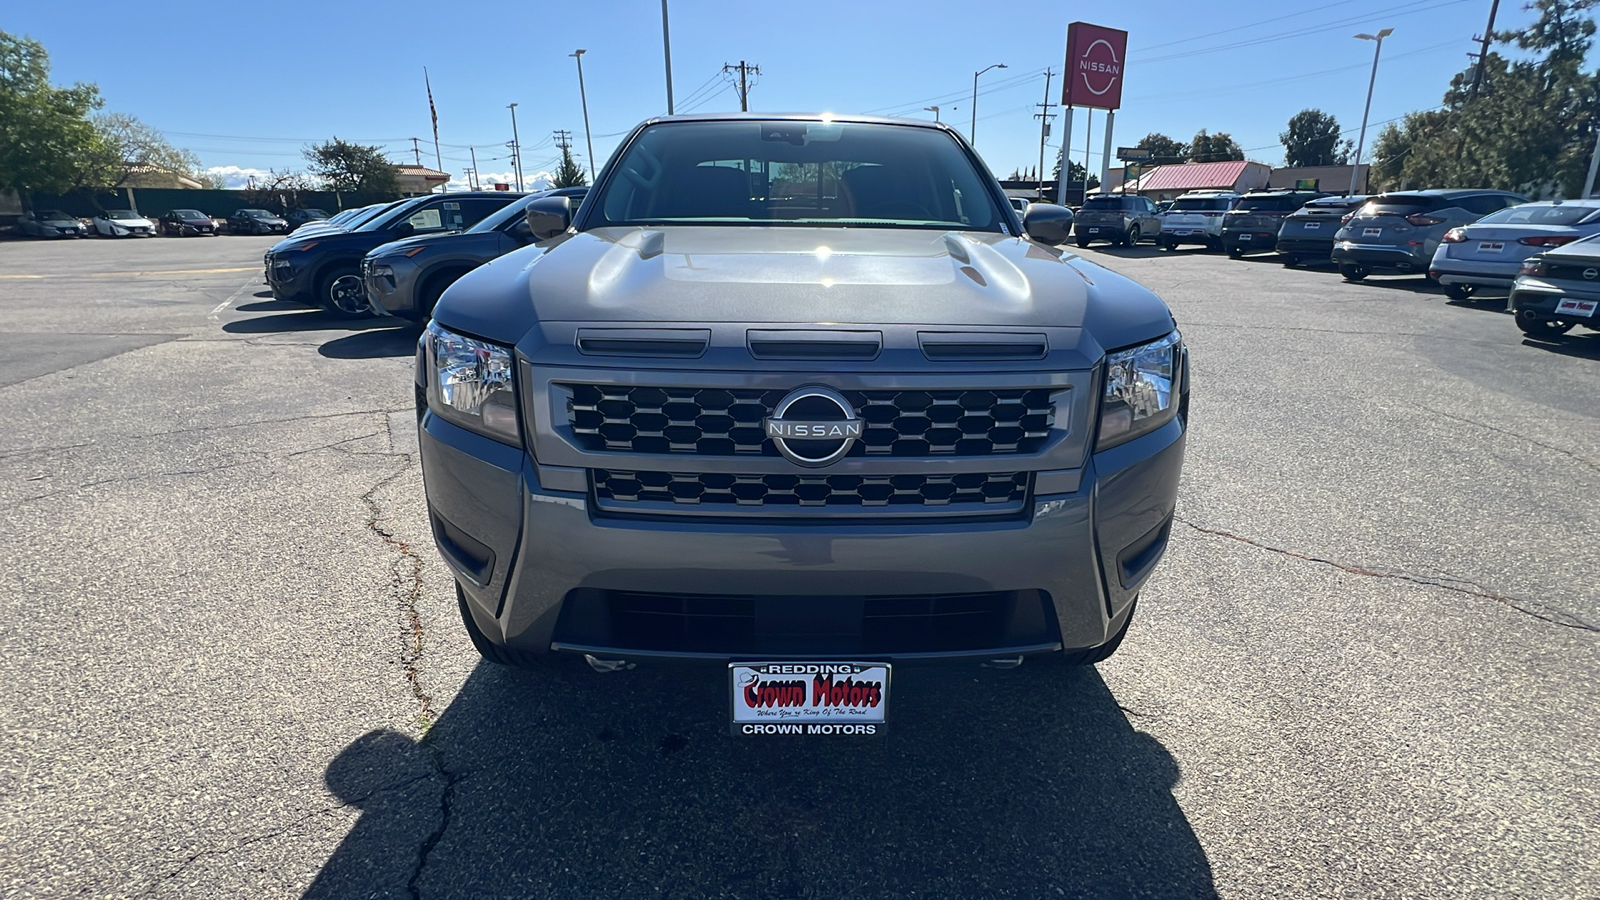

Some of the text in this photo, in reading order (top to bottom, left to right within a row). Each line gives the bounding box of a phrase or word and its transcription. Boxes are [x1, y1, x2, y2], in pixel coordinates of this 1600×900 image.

[1080, 60, 1119, 74] NISSAN
[769, 423, 859, 436] NISSAN
[769, 665, 851, 674] REDDING
[744, 675, 881, 708] Crown Motors
[742, 725, 876, 735] CROWN MOTORS
